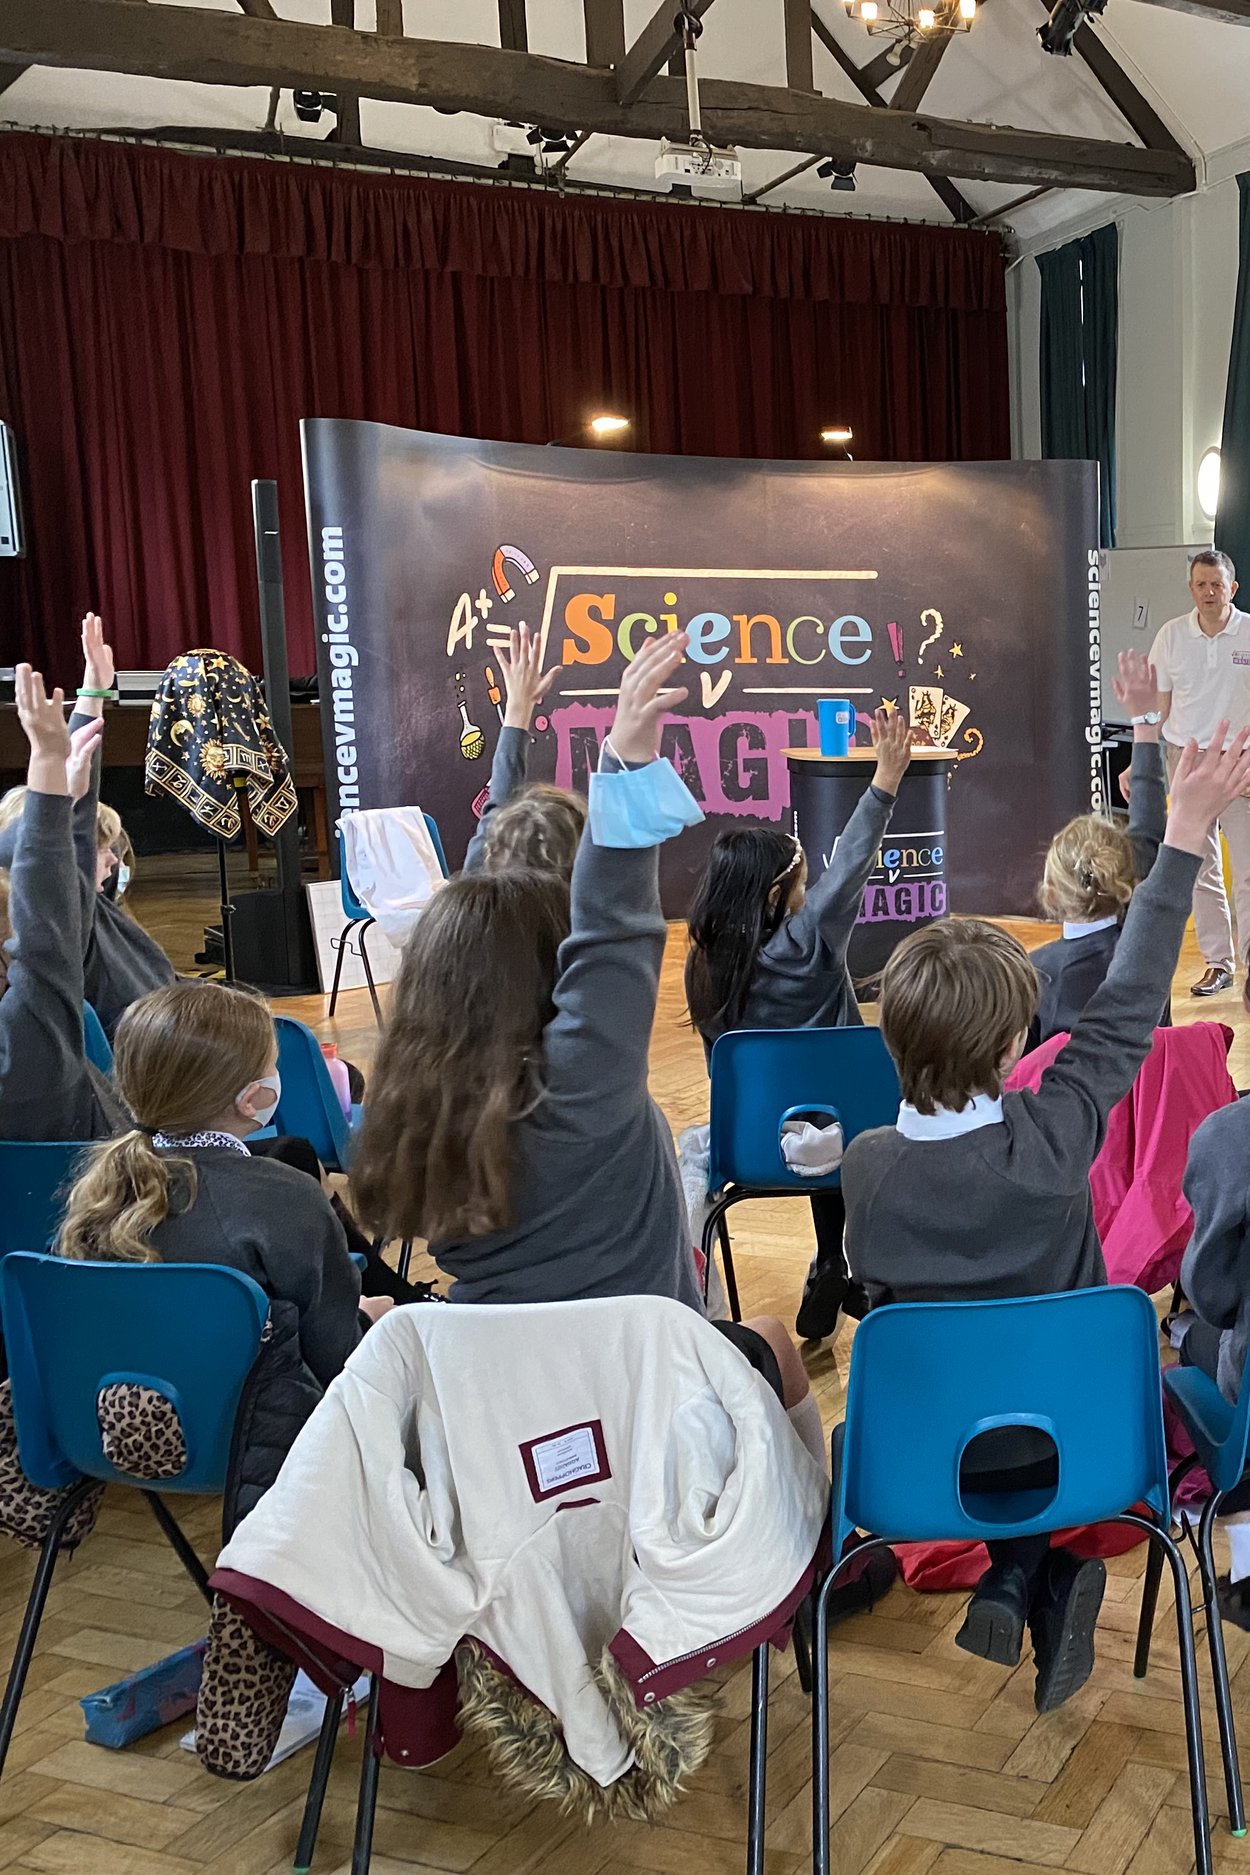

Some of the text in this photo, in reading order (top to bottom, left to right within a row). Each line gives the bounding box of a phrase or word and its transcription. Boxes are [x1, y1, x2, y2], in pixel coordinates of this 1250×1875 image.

[562, 592, 873, 666] Science
[1137, 605, 1144, 622] 7
[321, 526, 359, 838] ncevmagic.com
[1085, 549, 1103, 818] sciencevmagic.co
[876, 845, 944, 869] ience
[858, 883, 944, 918] AGIC
